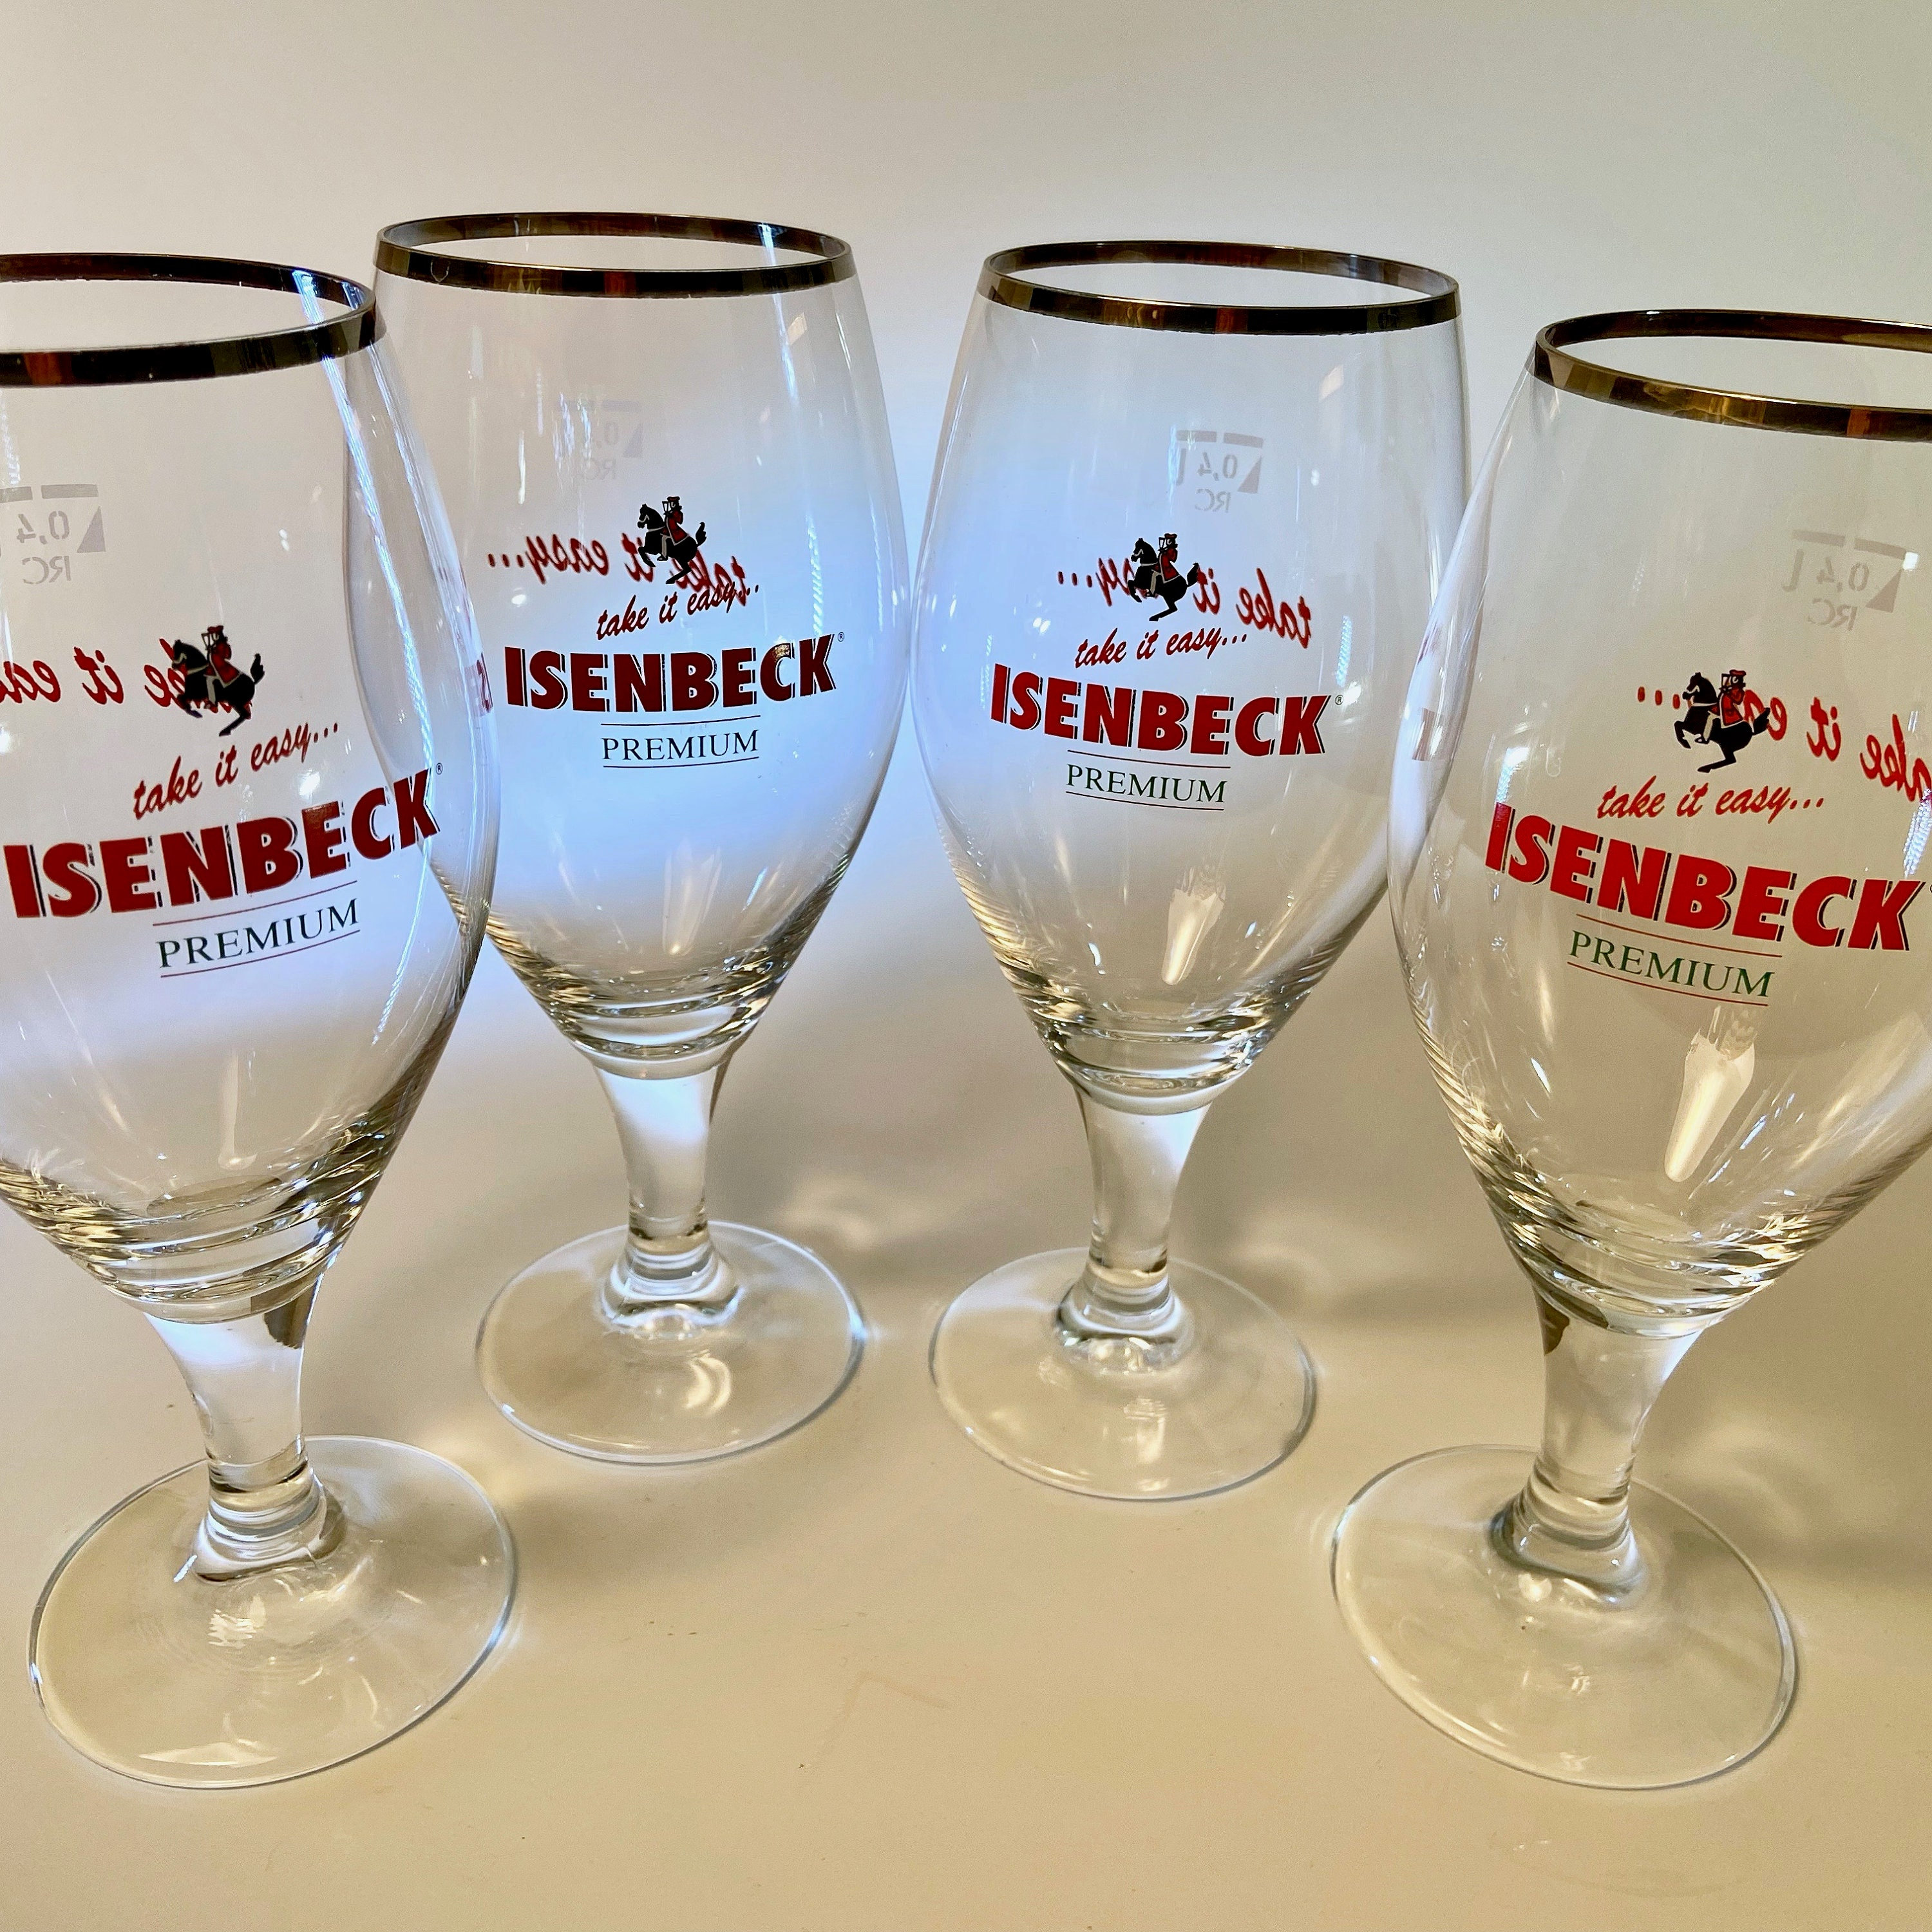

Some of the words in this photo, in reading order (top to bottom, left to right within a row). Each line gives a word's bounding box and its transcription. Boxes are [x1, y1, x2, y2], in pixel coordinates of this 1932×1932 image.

[596, 594, 649, 640] take
[659, 592, 677, 625] it
[1075, 628, 1126, 668] take
[1136, 629, 1159, 659] it
[601, 728, 759, 761] PREMIUM
[133, 755, 202, 820] take
[215, 744, 239, 788] it
[1066, 762, 1227, 804] PREMIUM
[1597, 775, 1666, 820] take
[1676, 782, 1709, 817] it
[156, 897, 359, 969] PREMIUM
[1569, 930, 1776, 999] PREMIUM
